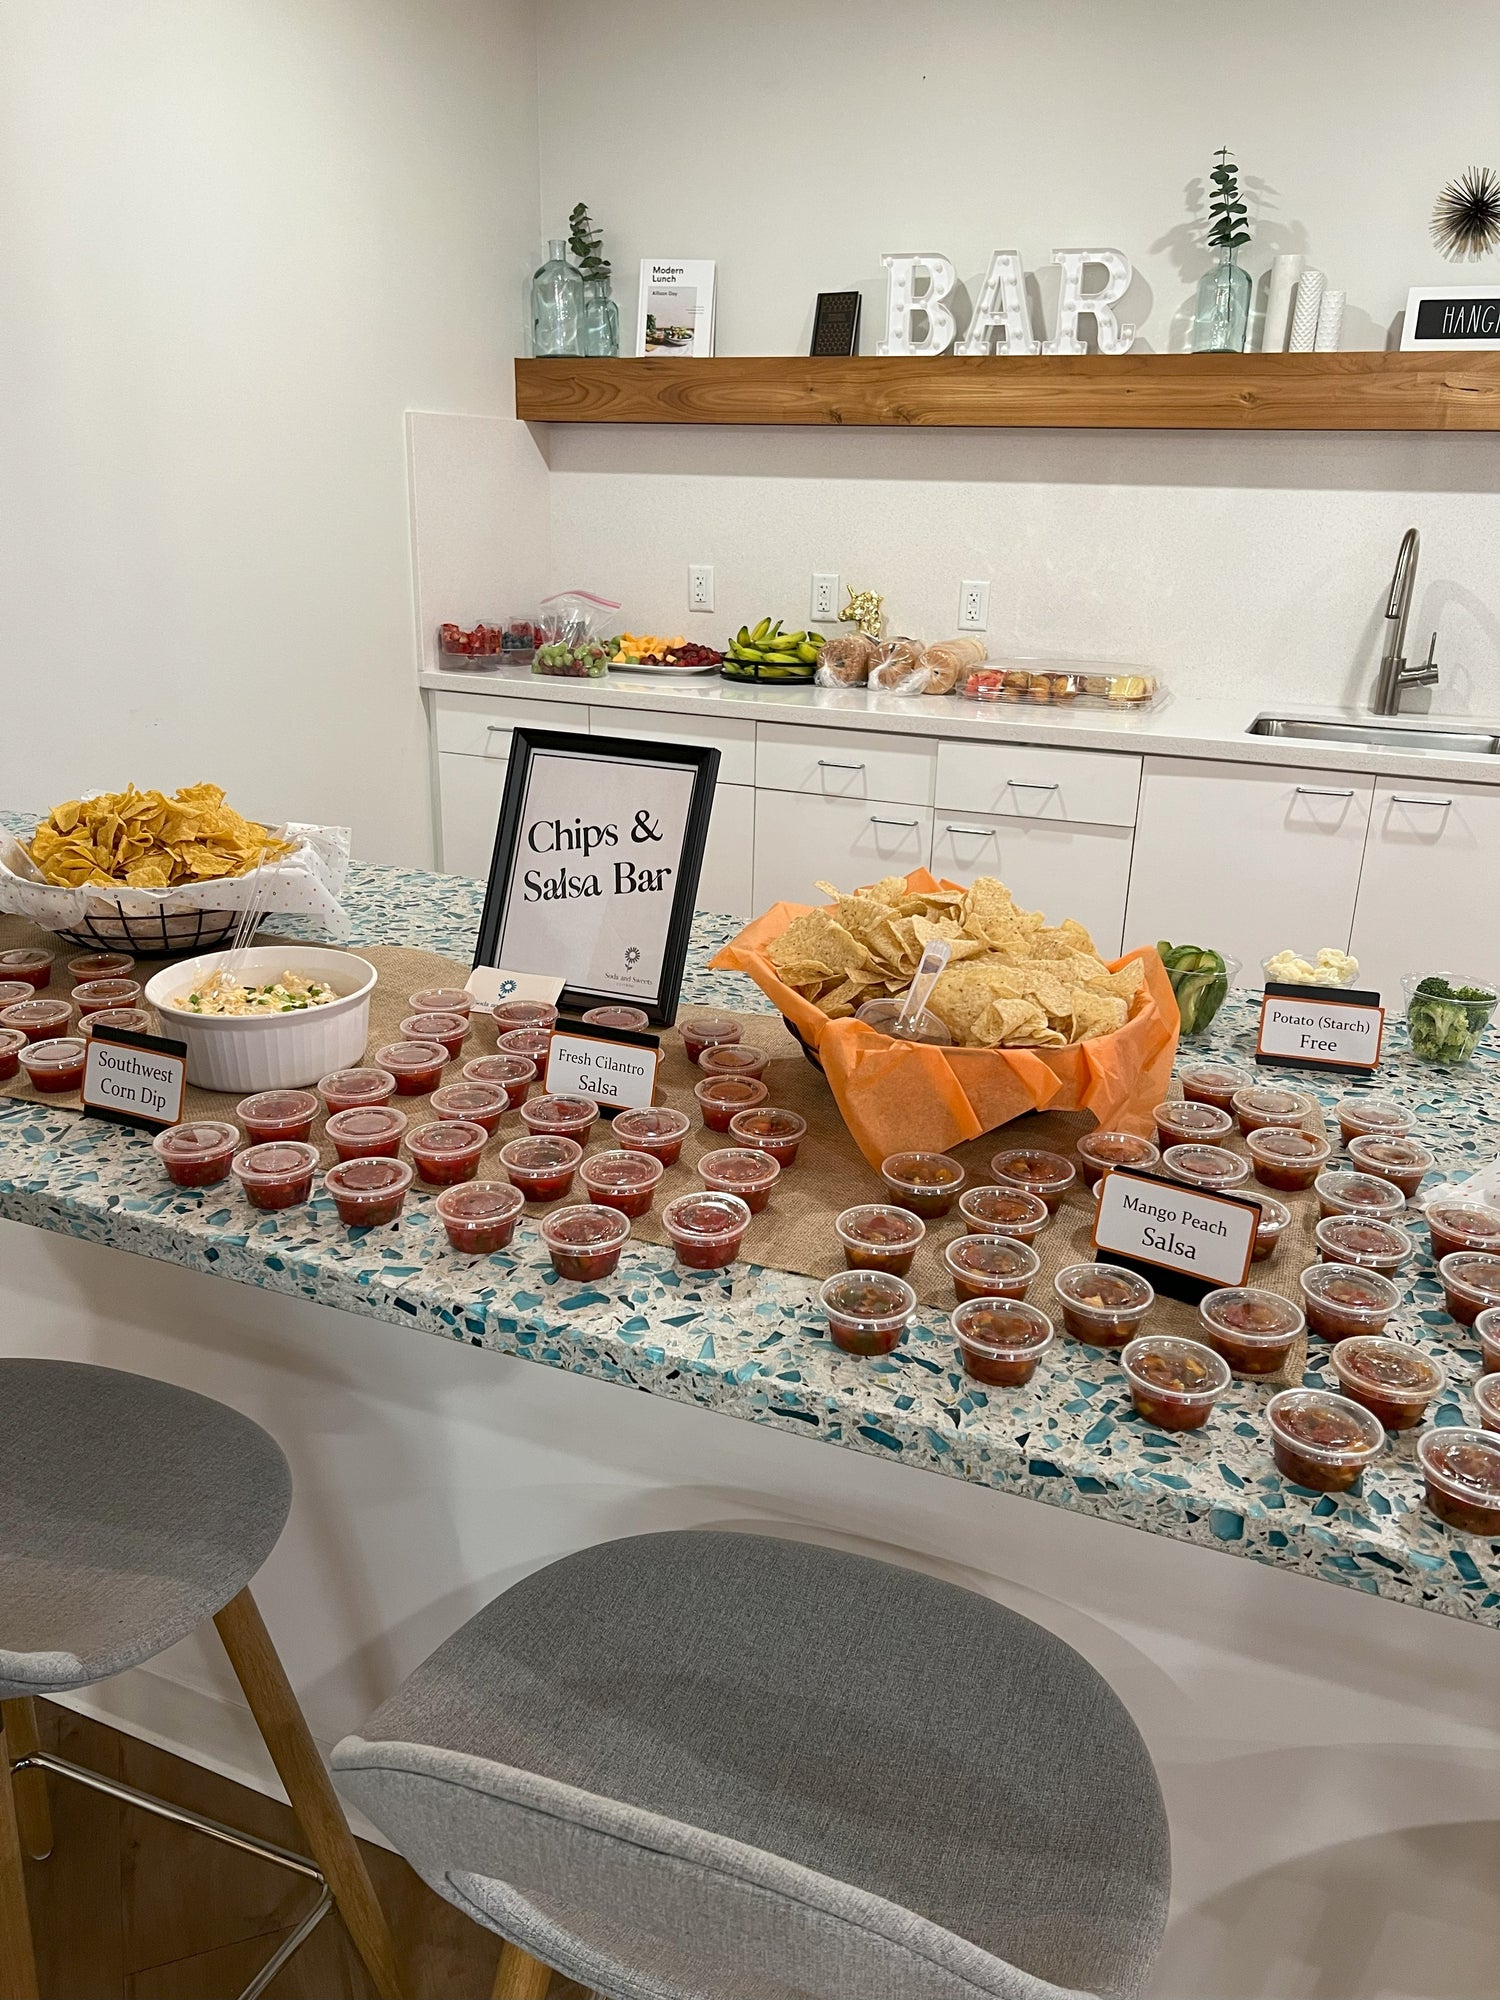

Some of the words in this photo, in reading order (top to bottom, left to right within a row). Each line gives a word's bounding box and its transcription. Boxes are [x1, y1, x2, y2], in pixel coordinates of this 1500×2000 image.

[652, 266, 684, 274] Modern
[652, 274, 677, 283] Lunch
[876, 248, 1136, 357] BAR
[527, 818, 619, 857] Chips
[630, 809, 663, 844] &
[523, 867, 602, 902] Salsa
[613, 861, 672, 895] Bar
[1273, 1011, 1314, 1027] Potato
[1318, 1016, 1370, 1035] (Starch)
[1300, 1034, 1337, 1052] Free
[98, 1050, 173, 1083] Southwest
[558, 1048, 591, 1066] Fresh
[595, 1055, 645, 1076] Cilantro
[100, 1077, 136, 1101] Corn
[140, 1086, 166, 1112] Dip
[578, 1074, 618, 1096] Salsa
[1122, 1194, 1176, 1223] Mango
[1181, 1210, 1228, 1238] Peach
[1141, 1226, 1197, 1260] Salsa
